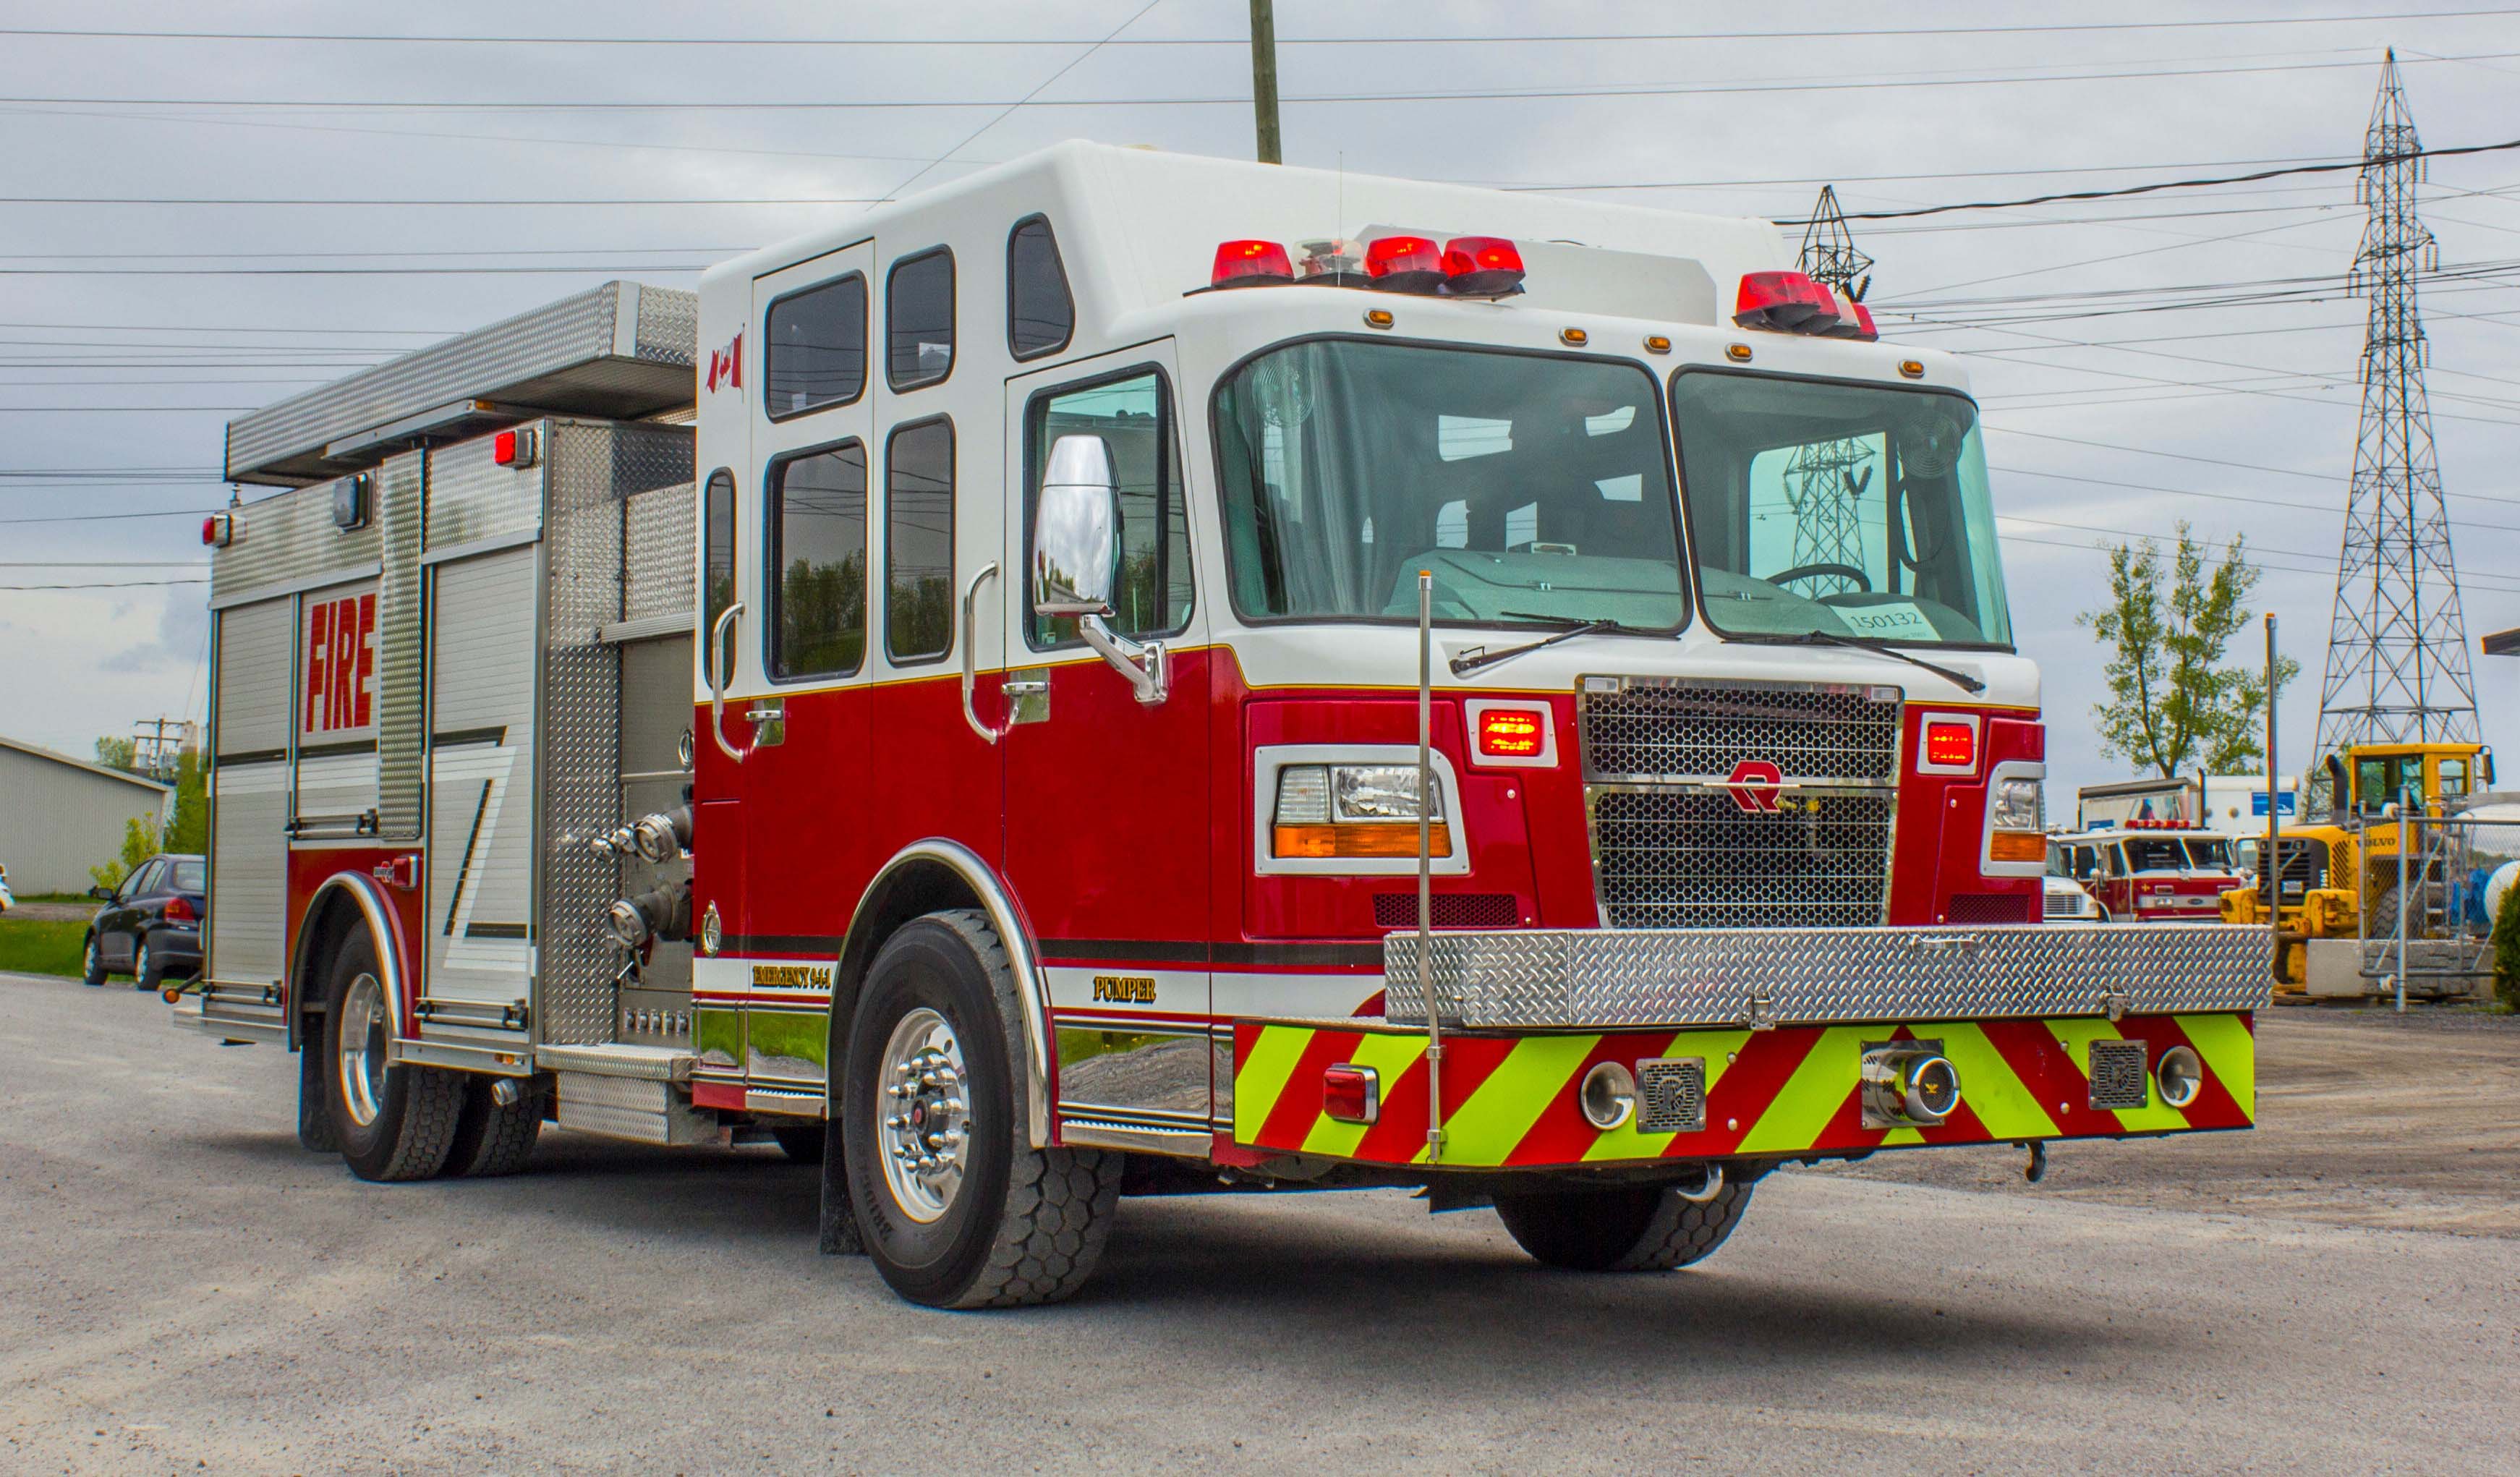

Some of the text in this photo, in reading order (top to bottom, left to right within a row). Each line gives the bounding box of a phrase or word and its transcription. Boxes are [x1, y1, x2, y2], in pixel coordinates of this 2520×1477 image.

[1850, 612, 1923, 629] 150132
[306, 593, 376, 733] FIRE
[752, 966, 810, 988] EMERGENCY
[1093, 976, 1156, 1004] PUMPER
